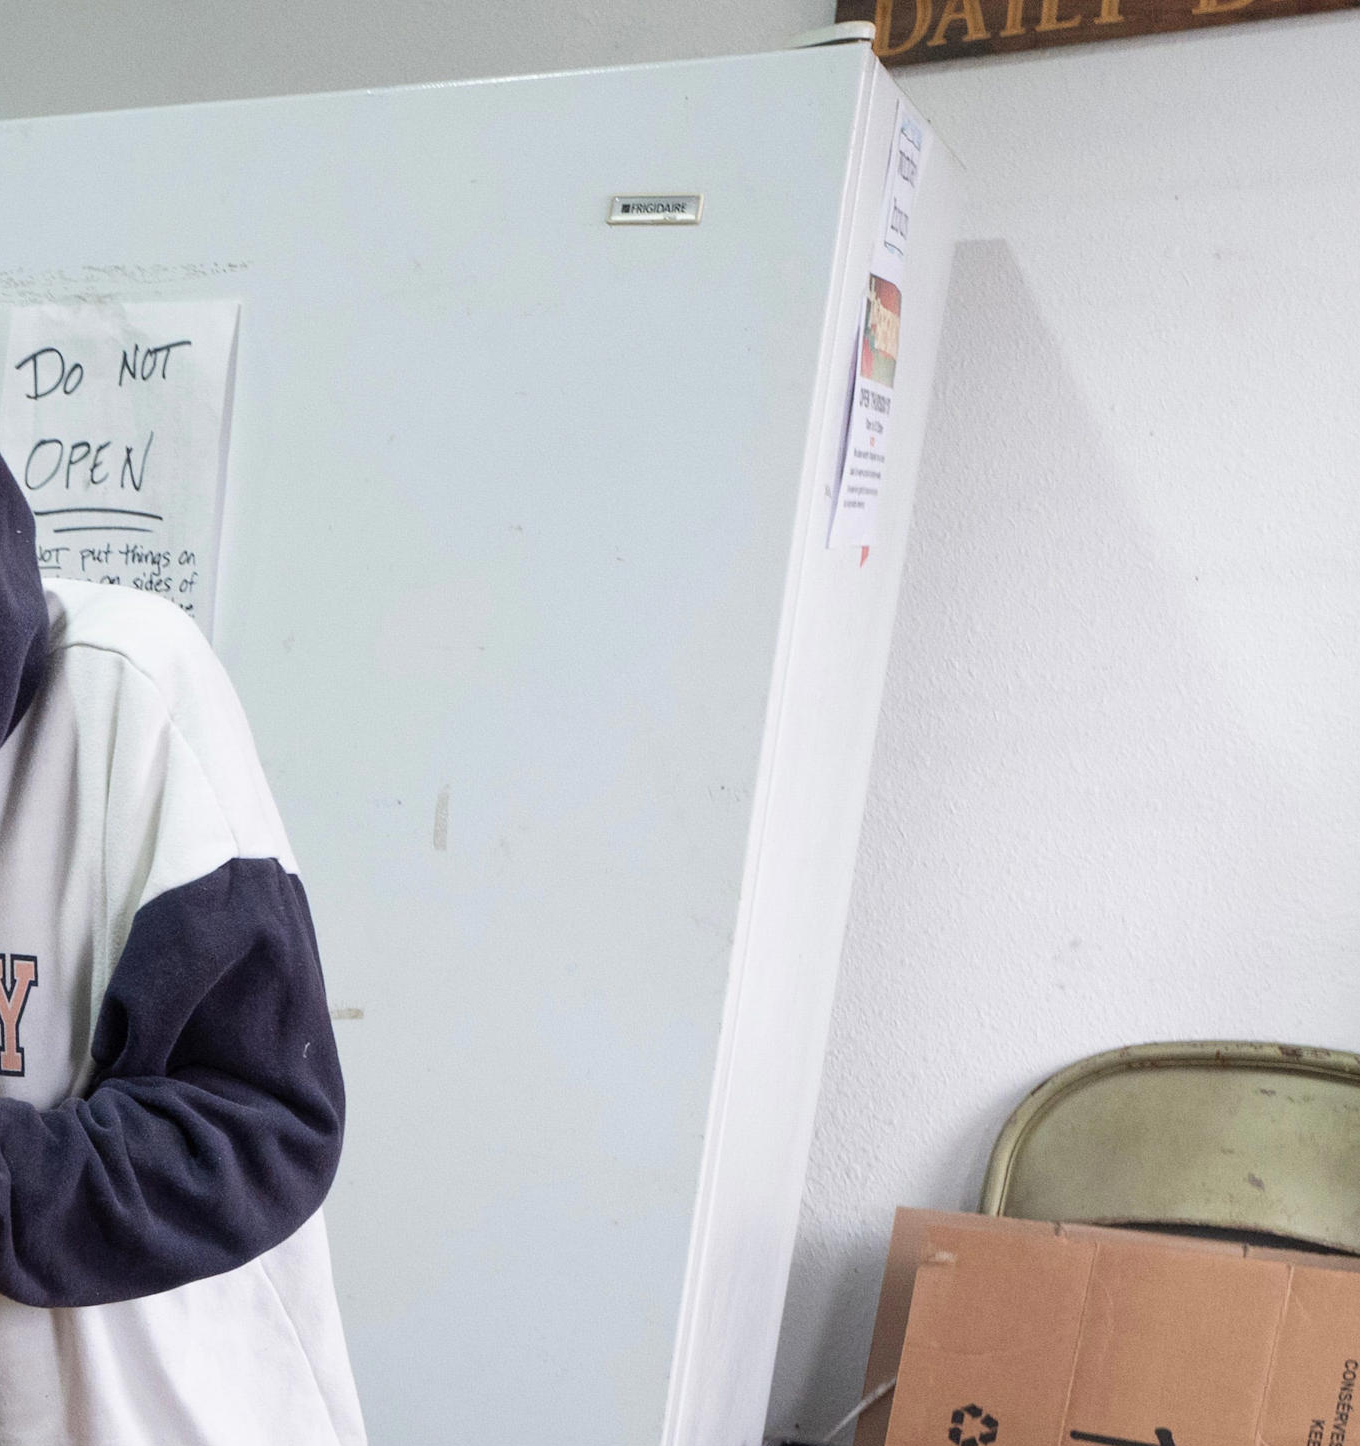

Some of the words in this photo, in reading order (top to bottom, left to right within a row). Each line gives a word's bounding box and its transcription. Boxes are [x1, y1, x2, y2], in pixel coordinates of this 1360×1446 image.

[630, 202, 688, 214] FRIGIDAIRE
[117, 339, 192, 387] NOT
[23, 430, 155, 493] OPEN
[80, 543, 115, 571] put
[118, 543, 171, 578] things
[177, 550, 197, 566] on
[132, 572, 173, 593] sides
[178, 572, 199, 594] of
